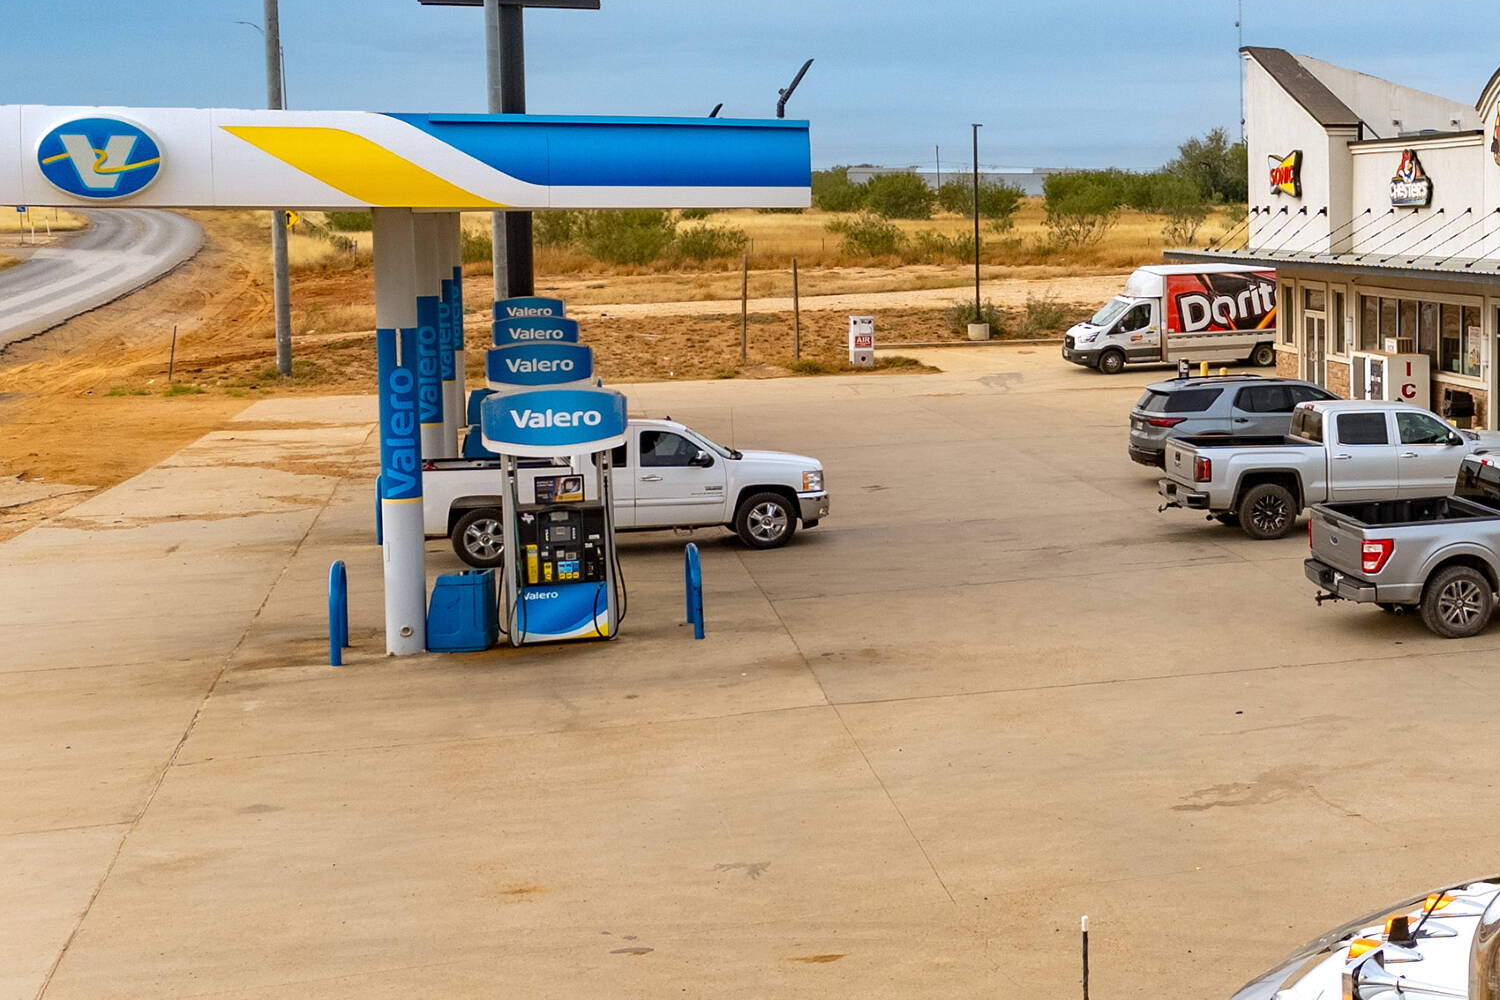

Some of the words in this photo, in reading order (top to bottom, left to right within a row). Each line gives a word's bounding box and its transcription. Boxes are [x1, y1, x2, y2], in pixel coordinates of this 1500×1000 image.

[1270, 166, 1295, 186] SONIC
[506, 306, 553, 317] Valero
[1180, 282, 1276, 332] Dorit
[508, 328, 564, 340] Valero
[856, 336, 872, 345] AIR
[418, 325, 438, 421] Valero
[505, 358, 574, 373] Valero
[509, 408, 602, 429] Valero
[386, 367, 416, 498] Valero
[524, 591, 559, 600] Valero
